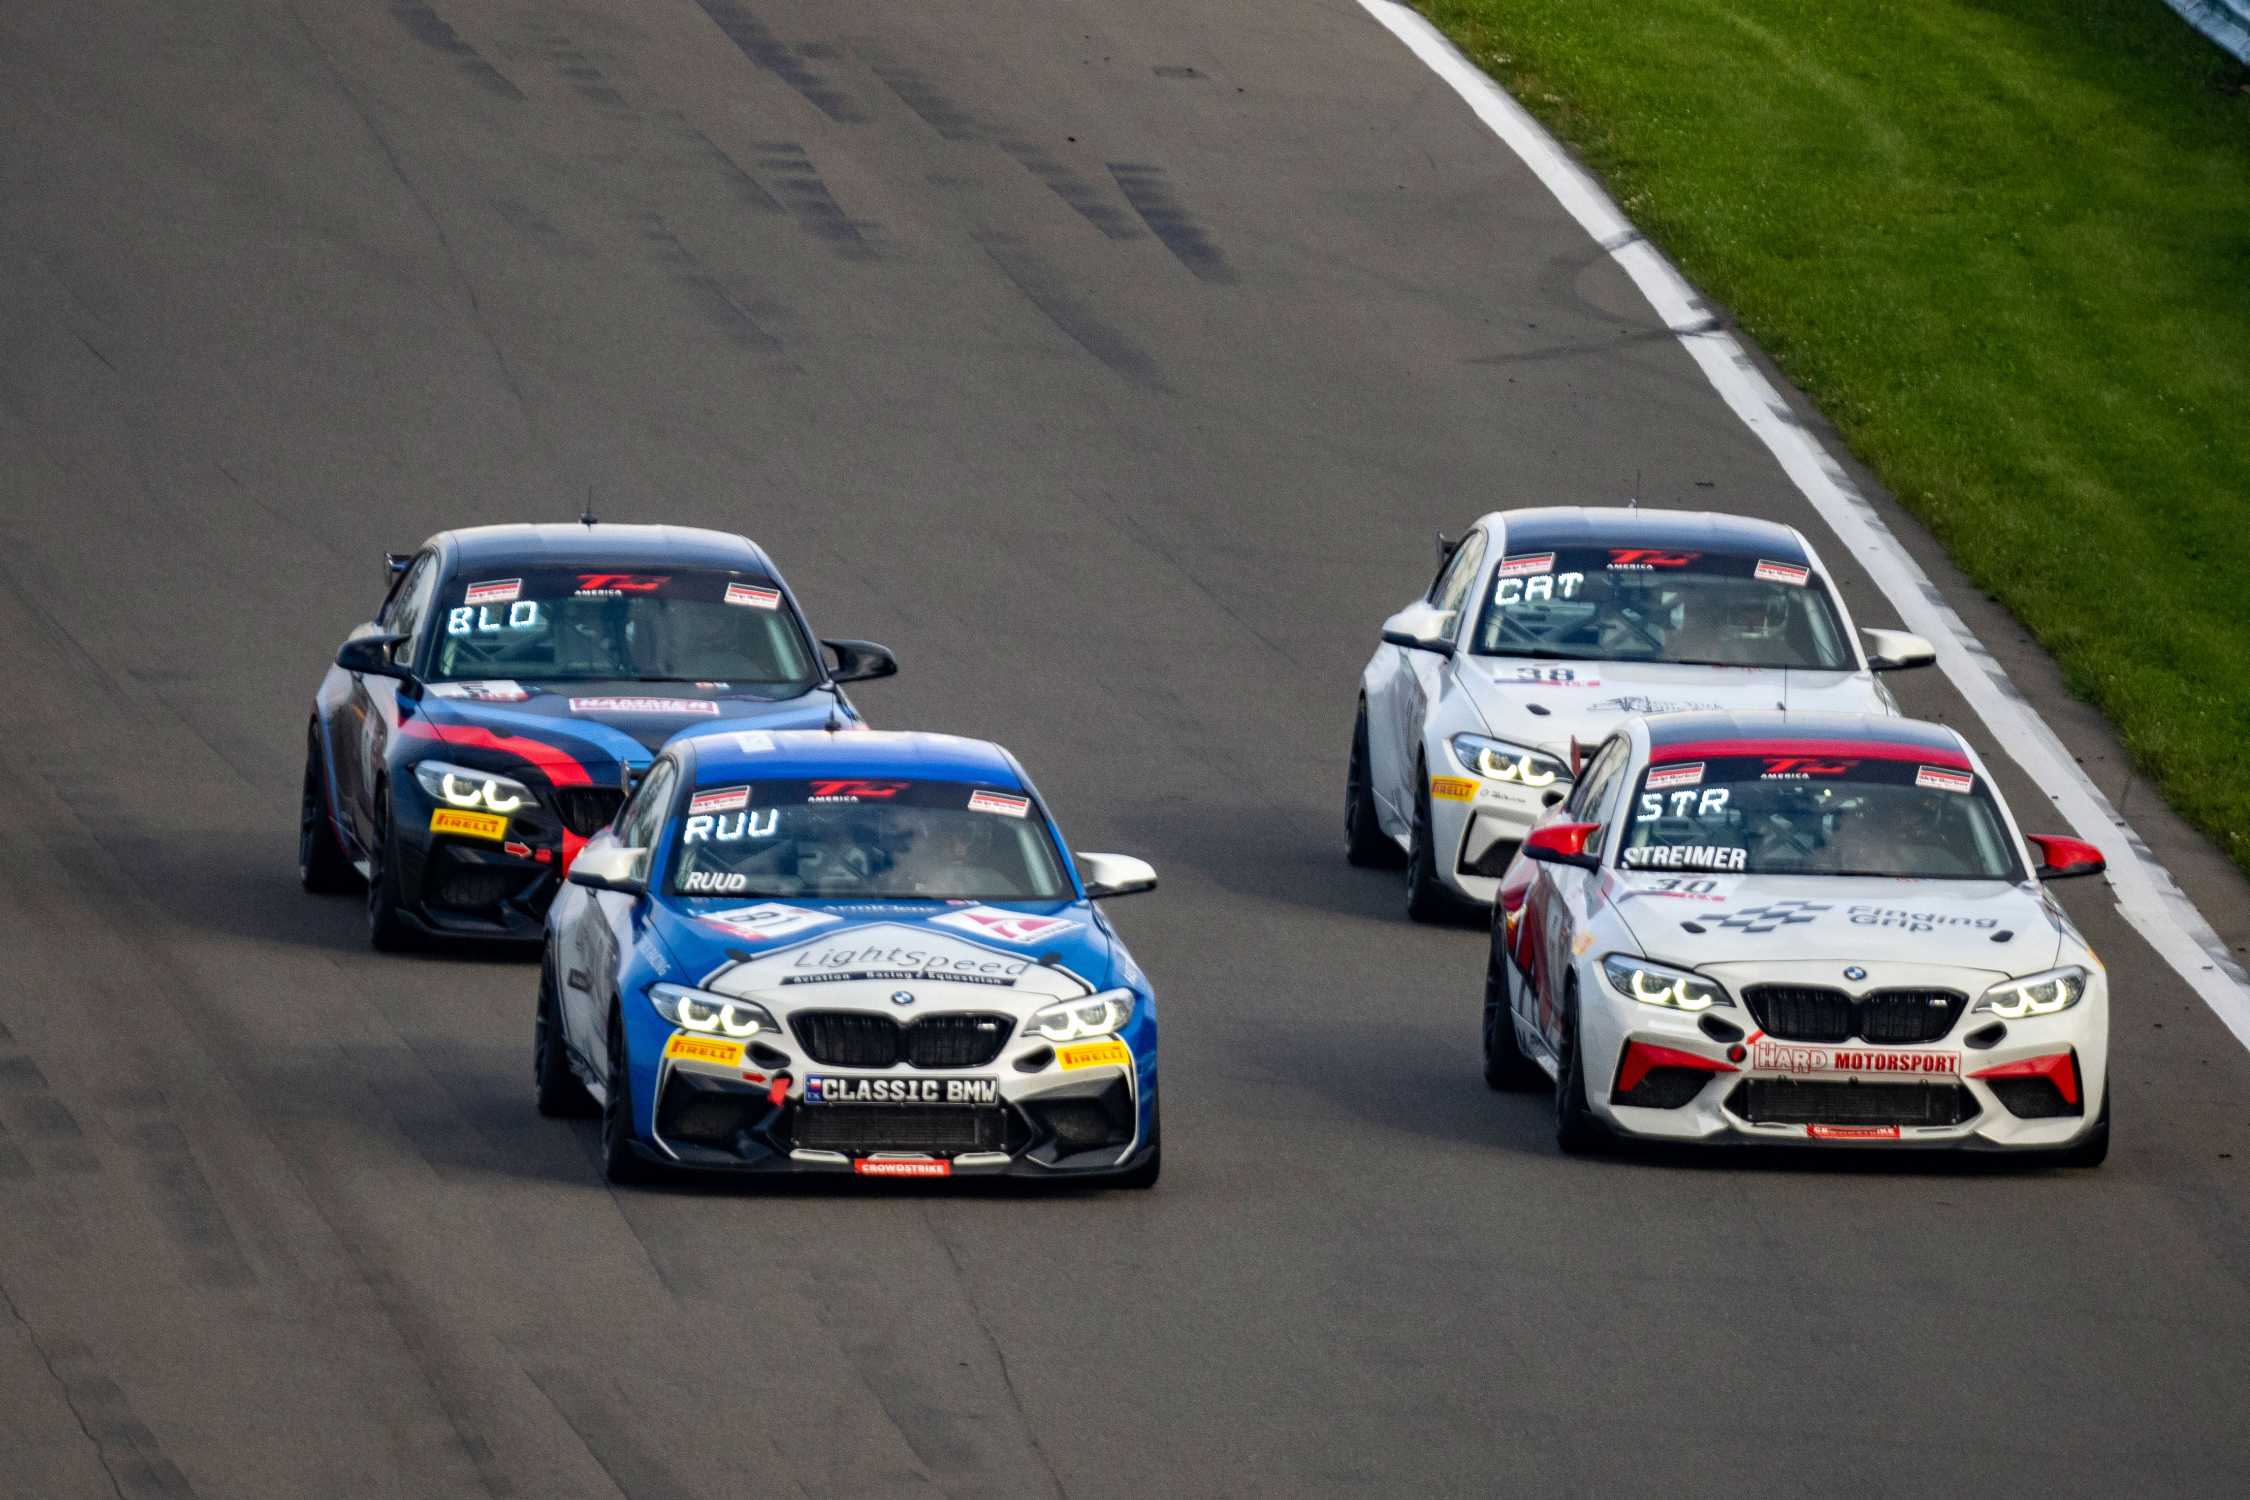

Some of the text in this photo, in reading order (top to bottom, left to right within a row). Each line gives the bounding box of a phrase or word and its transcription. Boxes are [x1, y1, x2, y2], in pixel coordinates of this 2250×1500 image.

[574, 589, 622, 597] AMERICA
[1495, 571, 1584, 606] CAT
[448, 600, 538, 636] BLO
[1432, 778, 1473, 797] PIRELLI
[1637, 788, 1730, 822] STR
[436, 812, 499, 833] PIRELLI
[683, 808, 779, 845] RUU
[1621, 845, 1748, 871] STREIMER
[685, 871, 747, 891] RUUD
[1847, 904, 1999, 928] Finding
[1850, 914, 1933, 932] Grip
[793, 973, 851, 985] Aviation
[671, 1040, 737, 1060] PIRELLI
[1064, 1046, 1123, 1064] PIRELLI
[1755, 1042, 1958, 1073] HARD MOTORSPORT
[821, 1079, 997, 1102] CLASSIC BMW
[861, 1164, 944, 1173] CROWDSTRIKE
